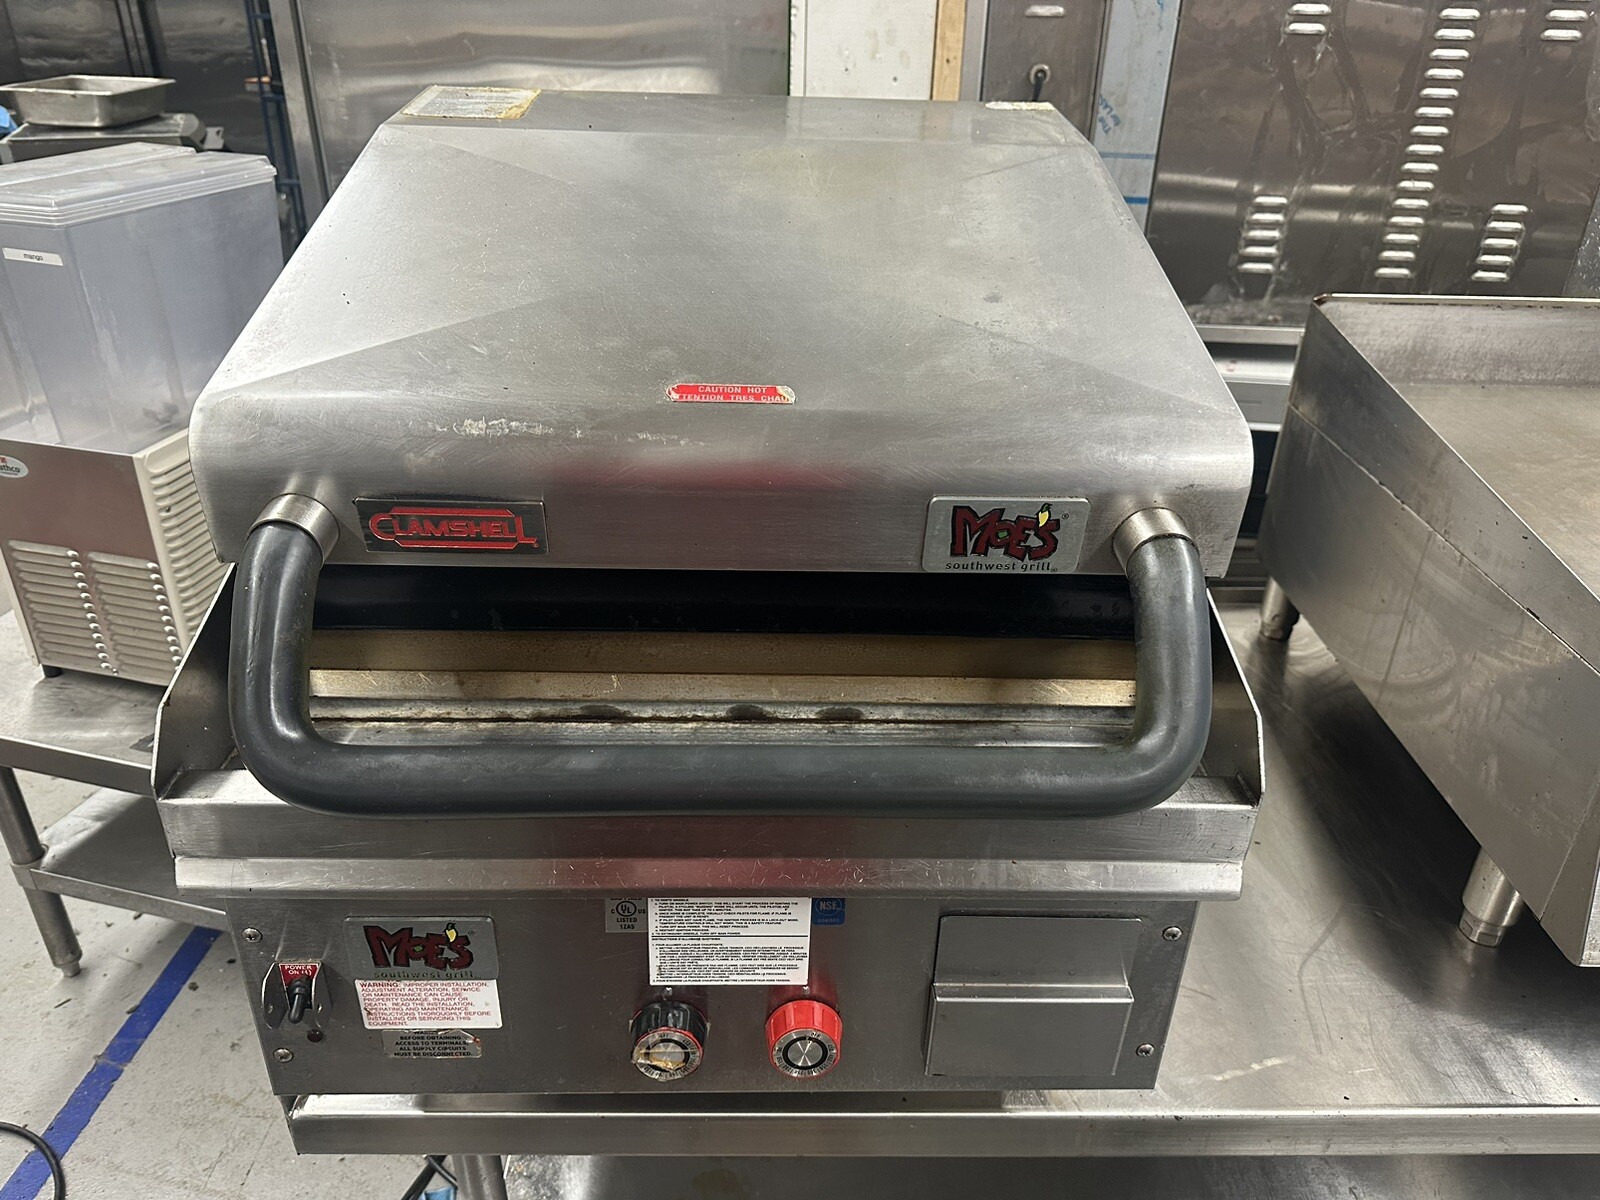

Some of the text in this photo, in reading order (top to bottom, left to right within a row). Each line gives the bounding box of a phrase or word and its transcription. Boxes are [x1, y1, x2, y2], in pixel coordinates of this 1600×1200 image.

[23, 253, 44, 261] mango
[698, 385, 767, 394] CAUTION HOT
[730, 394, 755, 402] TRES
[369, 513, 537, 544] CLAMSHELL
[946, 561, 1051, 573] southwest grill
[820, 901, 838, 910] NSF
[374, 971, 474, 980] southwest grill
